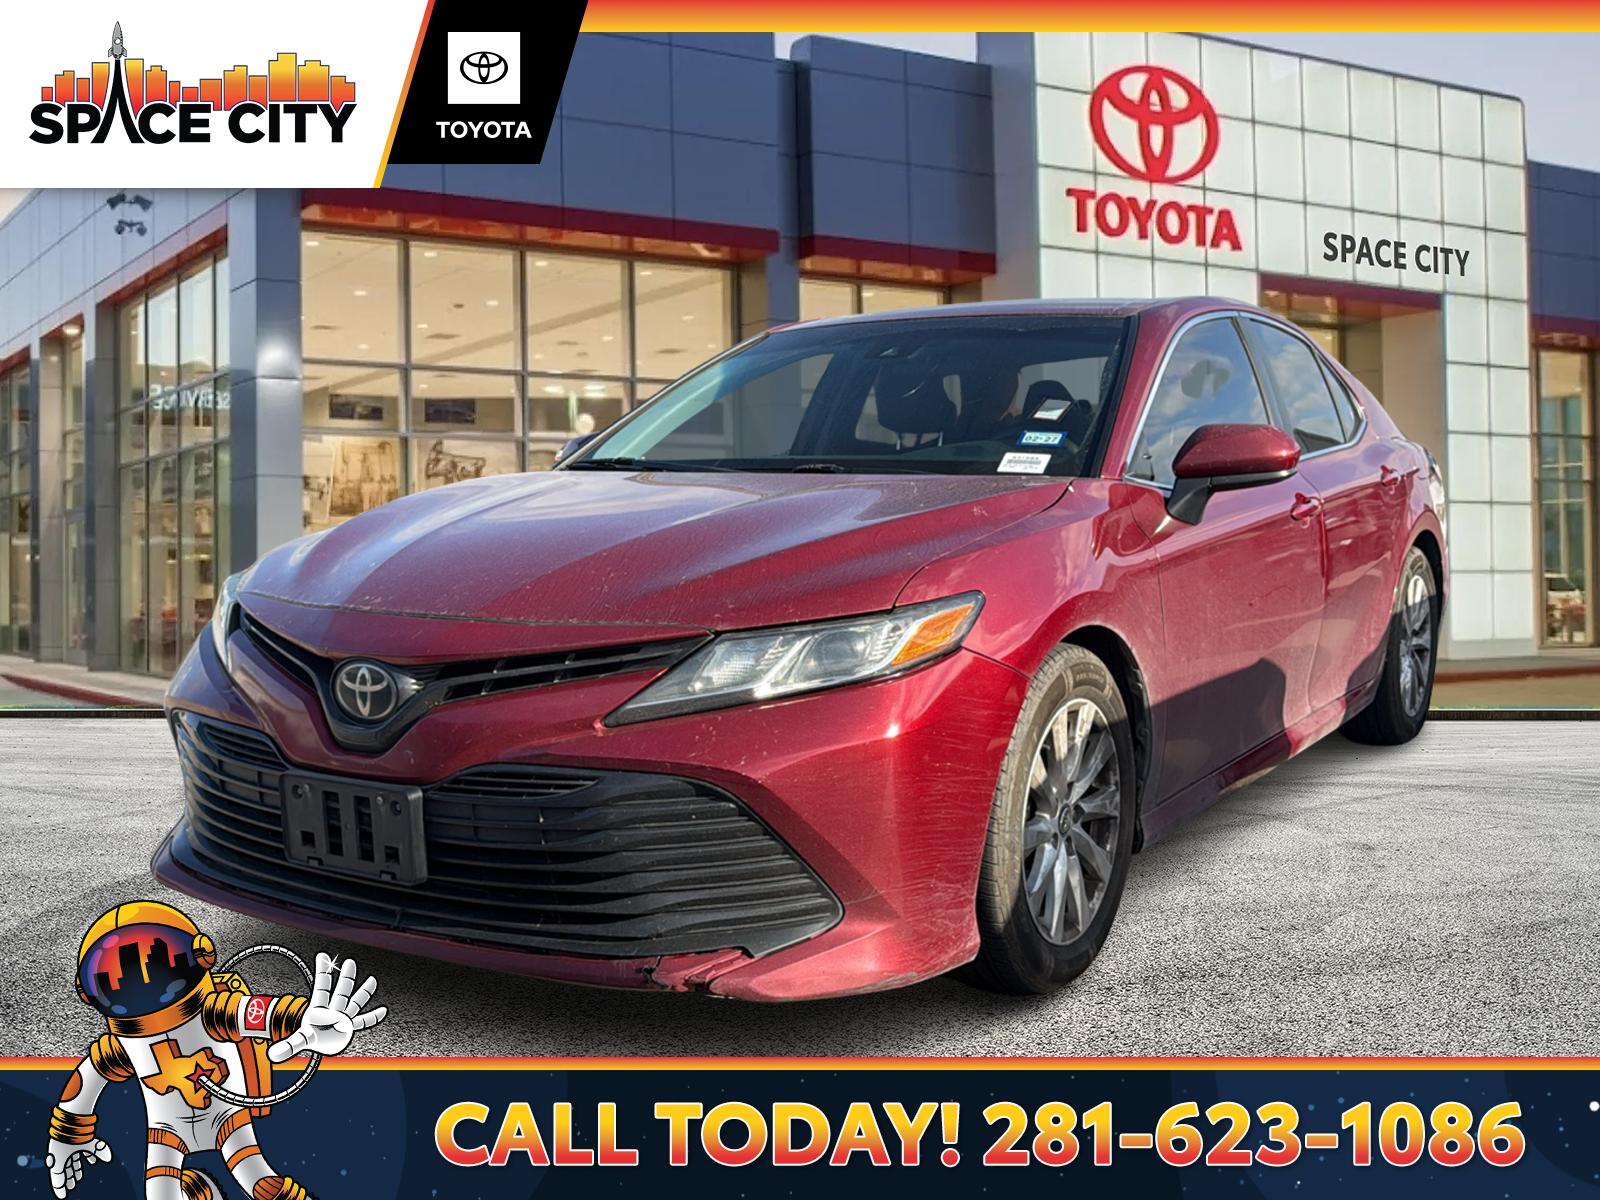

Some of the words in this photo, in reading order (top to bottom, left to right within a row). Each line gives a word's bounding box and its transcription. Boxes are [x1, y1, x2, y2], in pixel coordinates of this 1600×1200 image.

[1066, 187, 1243, 251] TOYOTA
[1323, 231, 1407, 270] SPACE
[1415, 244, 1470, 277] CITY
